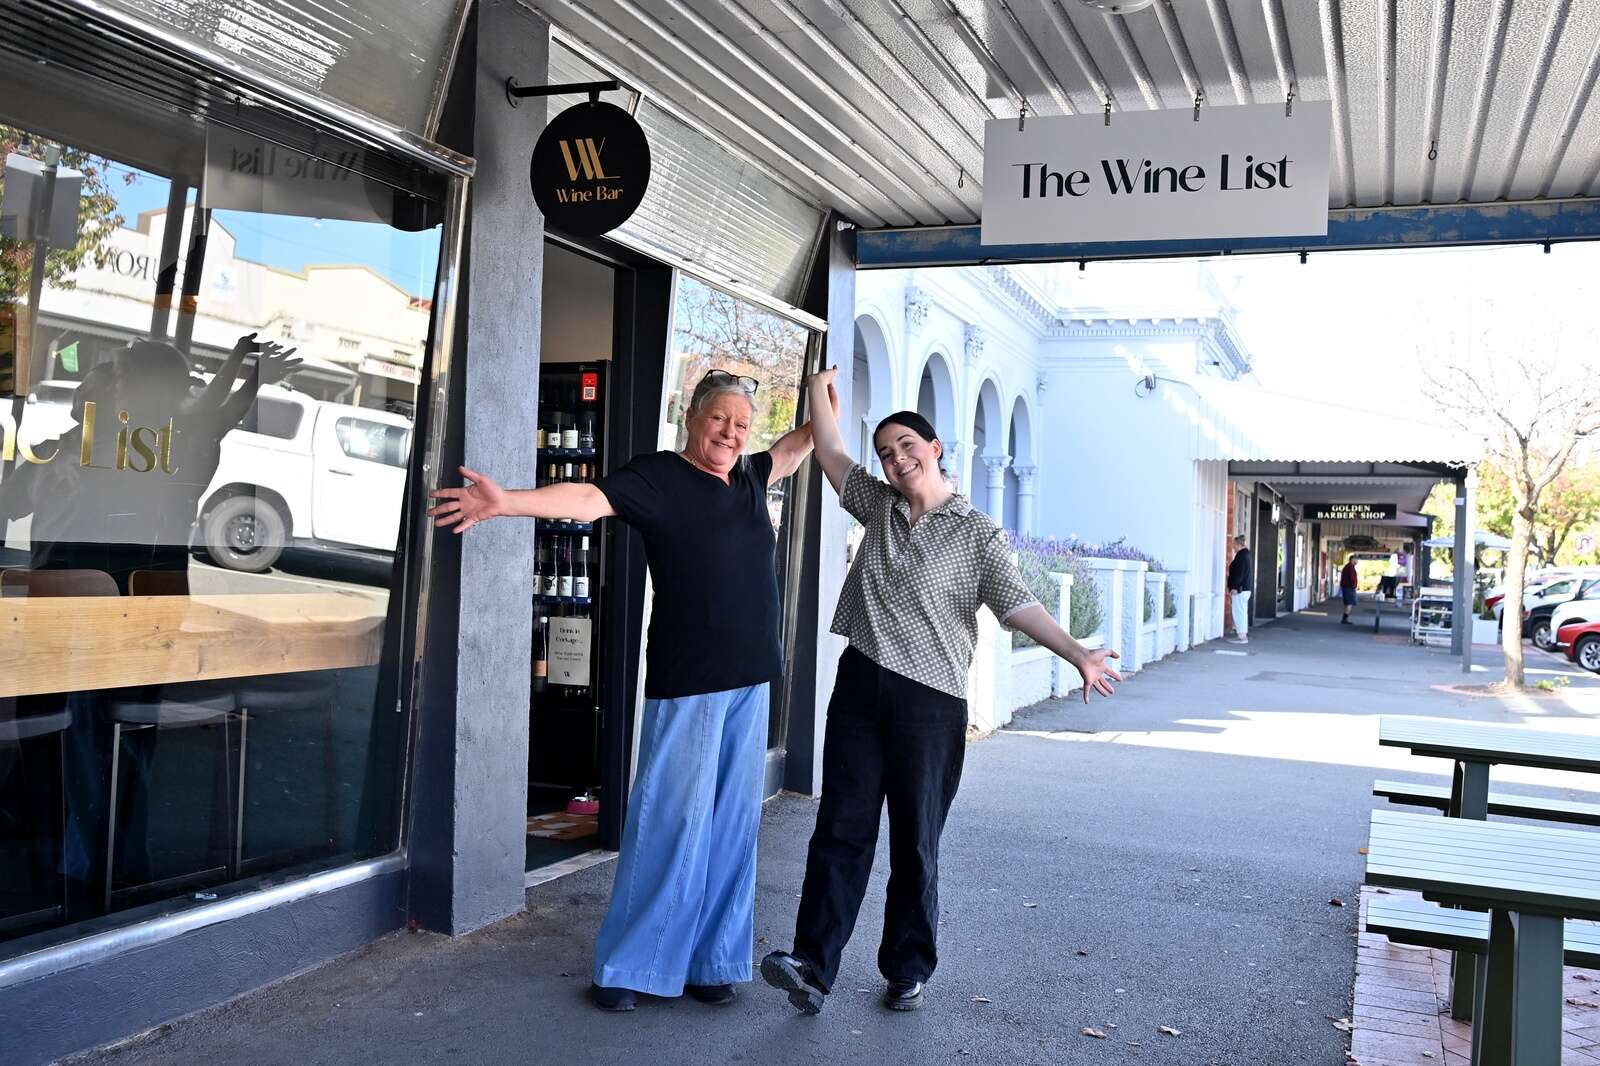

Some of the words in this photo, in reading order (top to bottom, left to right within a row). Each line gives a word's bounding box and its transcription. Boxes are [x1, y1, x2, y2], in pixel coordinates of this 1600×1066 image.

[1011, 162, 1090, 199] The
[1101, 157, 1206, 195] Wine
[1220, 153, 1294, 191] List
[556, 188, 593, 203] Wine
[596, 186, 623, 201] Bar
[80, 401, 179, 476] List
[1317, 511, 1355, 519] BARBER
[1360, 511, 1386, 519] SHOP
[1331, 504, 1370, 512] GOLDEN
